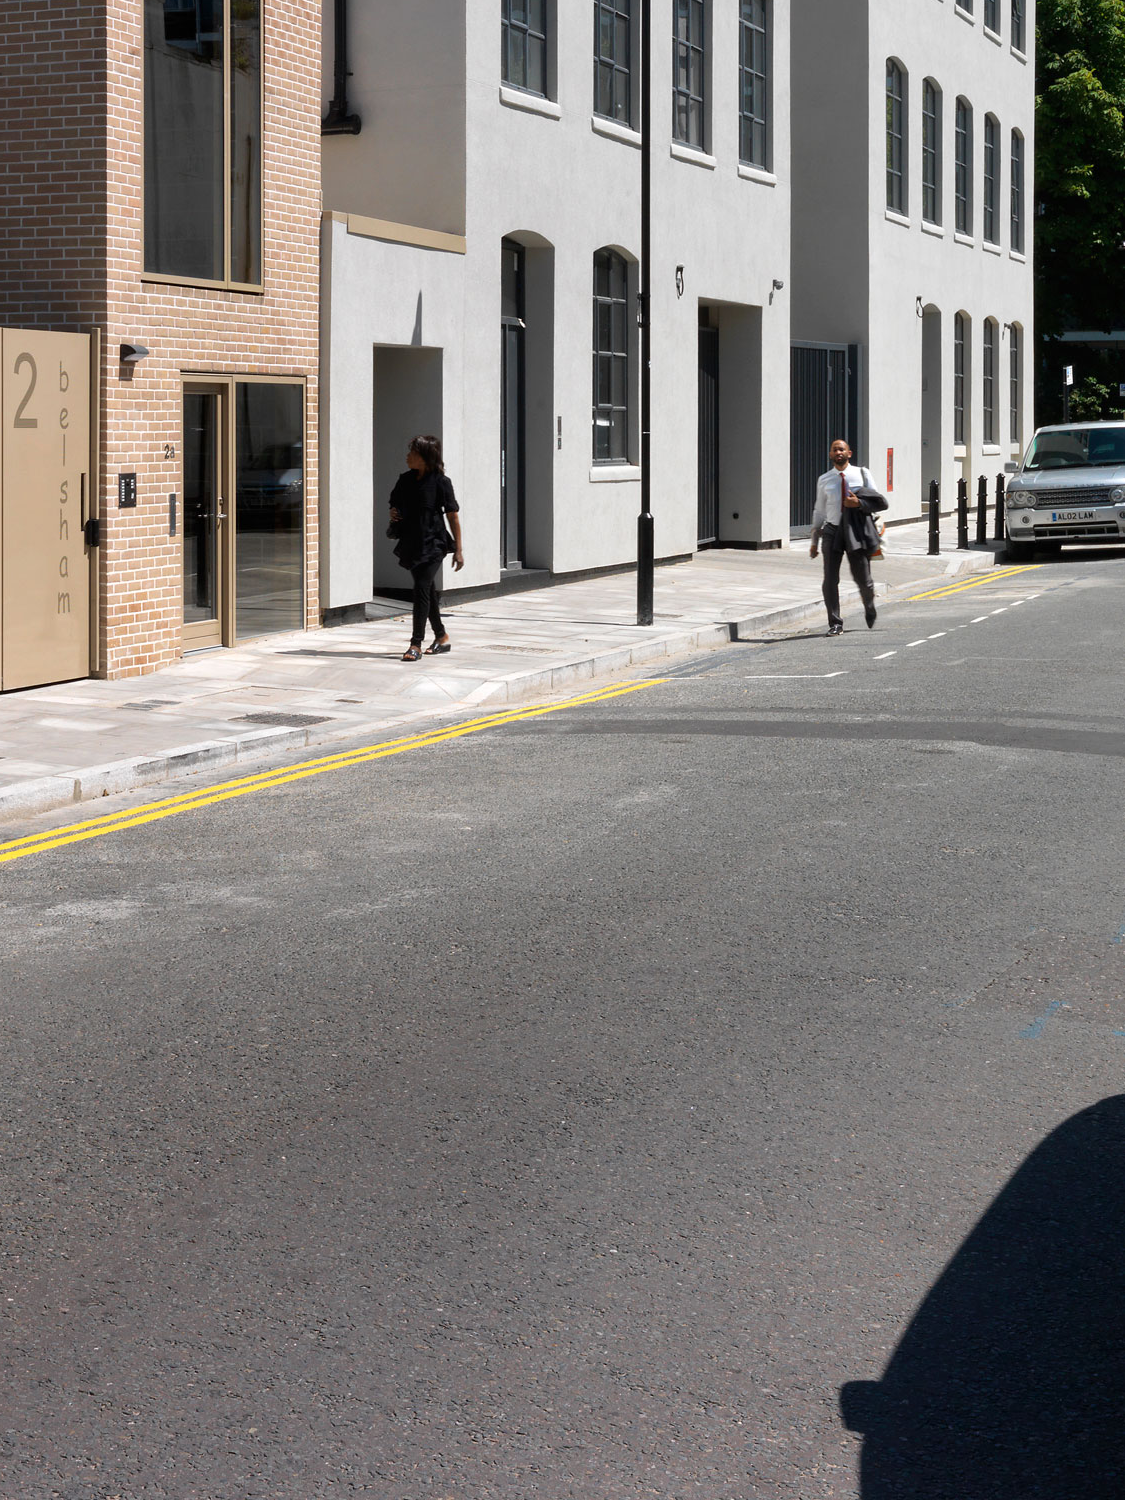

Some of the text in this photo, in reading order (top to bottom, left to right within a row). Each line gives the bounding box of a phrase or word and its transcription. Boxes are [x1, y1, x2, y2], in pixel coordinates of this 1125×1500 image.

[13, 352, 38, 429] 2
[57, 360, 71, 615] belsham
[1078, 511, 1094, 520] LAM
